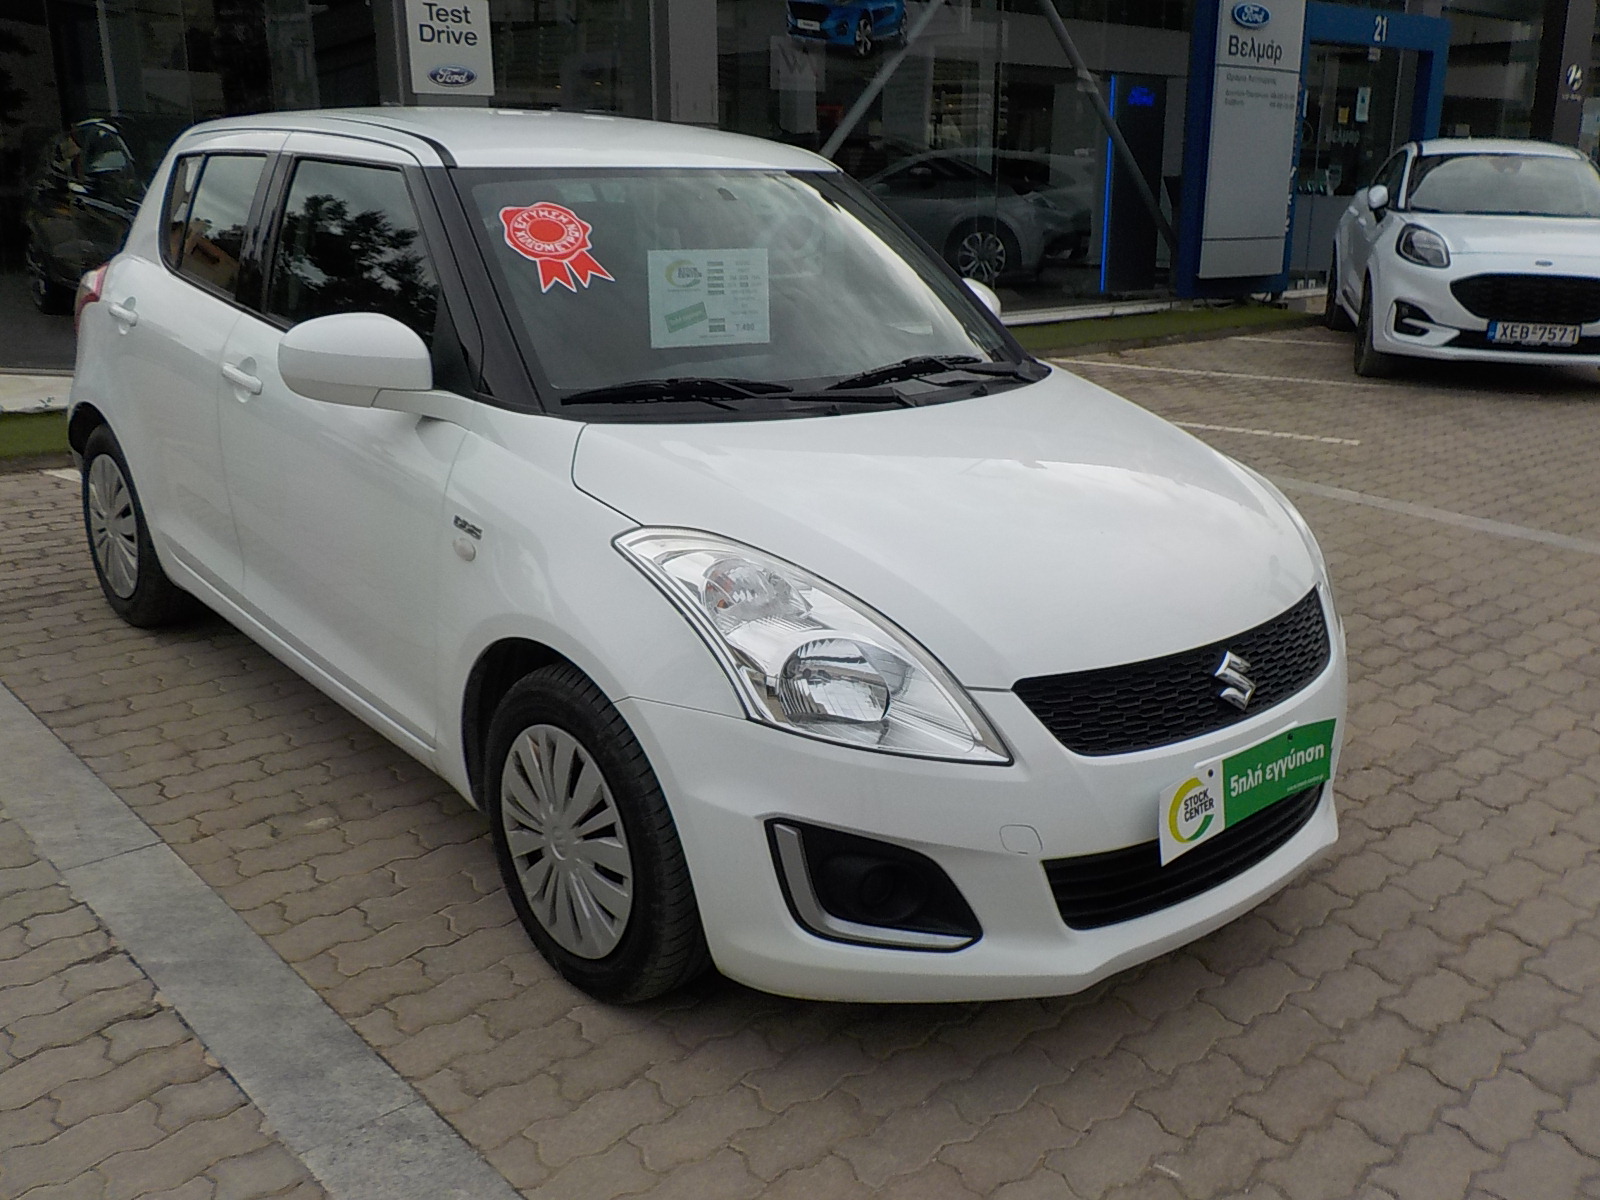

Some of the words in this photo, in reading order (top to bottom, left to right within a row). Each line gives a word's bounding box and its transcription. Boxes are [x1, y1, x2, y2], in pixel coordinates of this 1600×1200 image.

[423, 3, 471, 24] Test
[1238, 4, 1267, 23] Ford
[419, 24, 478, 46] Drive
[1373, 15, 1388, 42] 21
[1228, 34, 1282, 64] Βελμάρ
[433, 67, 470, 83] Ford
[1230, 763, 1262, 797] 5πλή
[1265, 743, 1325, 782] εγγύηση
[1183, 788, 1209, 811] STOCK
[1184, 797, 1214, 822] CENTER
